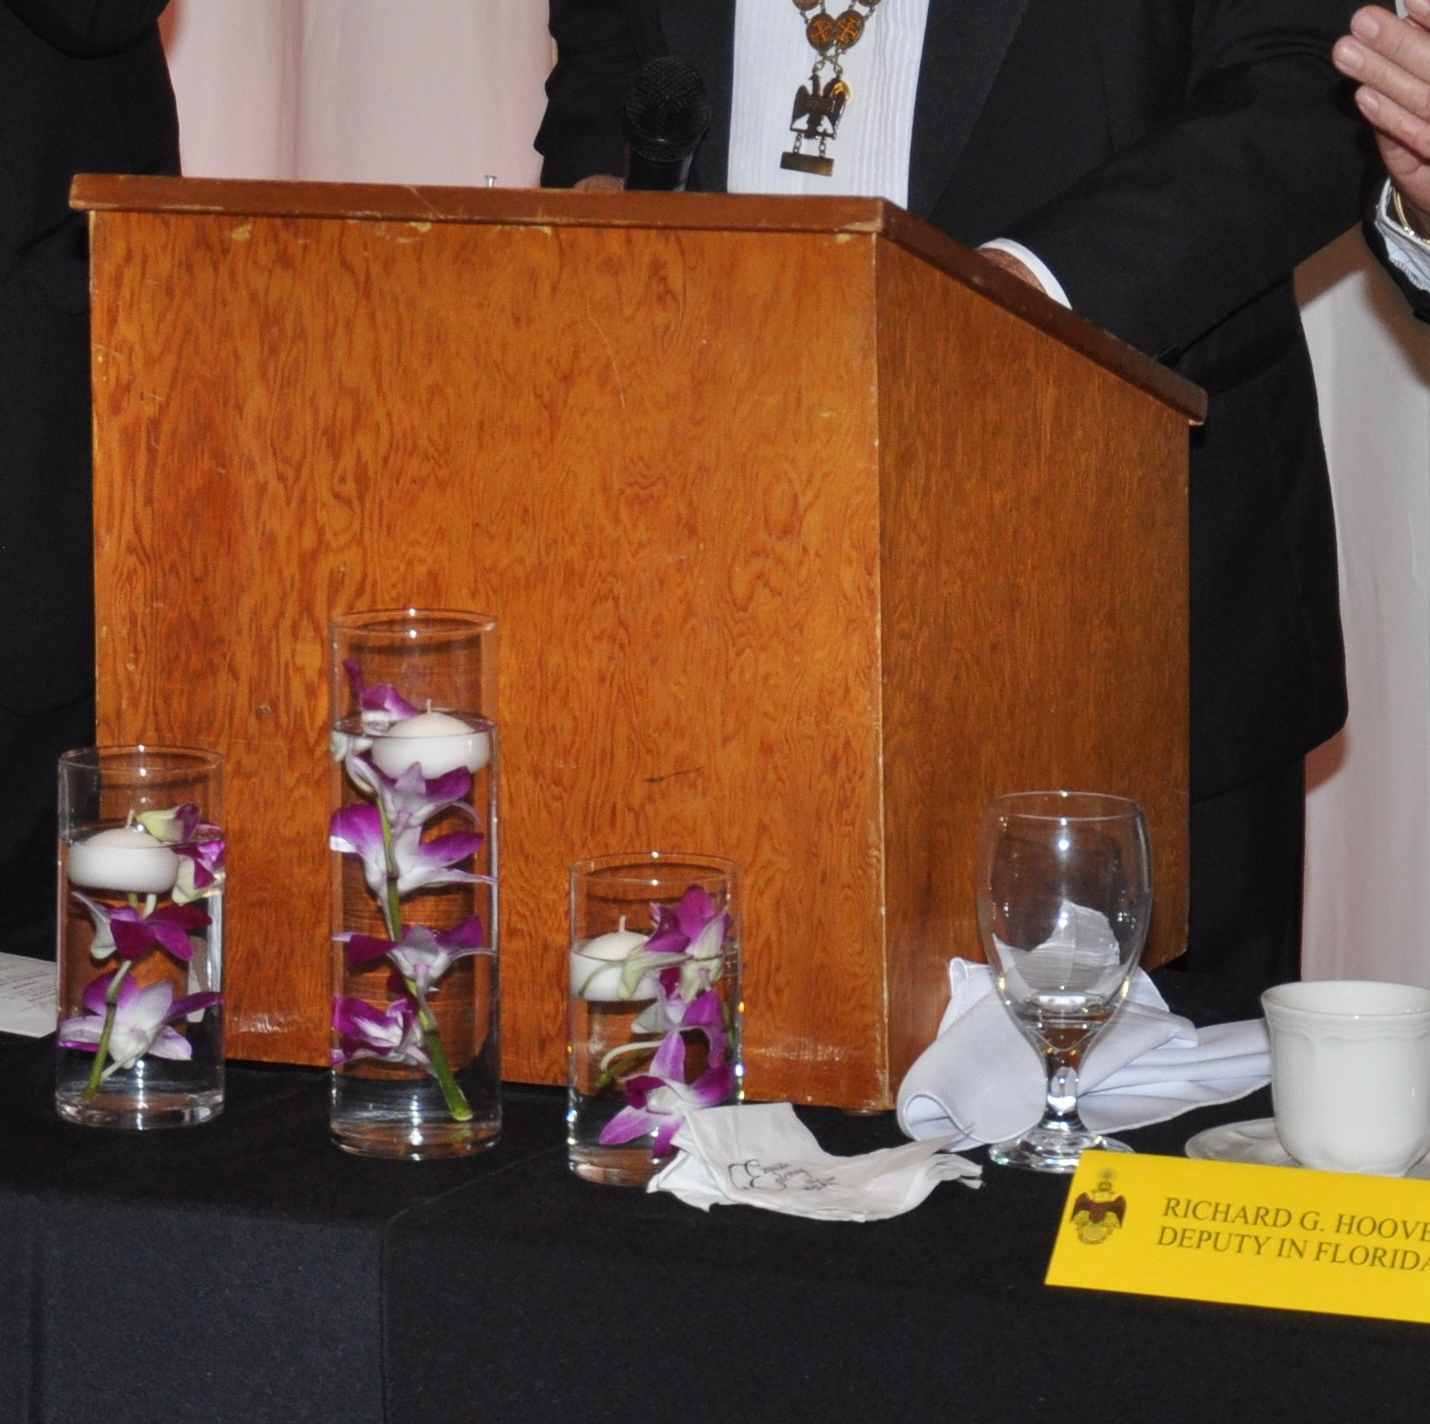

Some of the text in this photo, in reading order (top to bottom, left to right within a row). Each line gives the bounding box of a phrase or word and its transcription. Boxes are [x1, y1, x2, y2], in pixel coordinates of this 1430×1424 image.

[1162, 1197, 1293, 1228] RICHARD
[1299, 1210, 1325, 1232] G.
[1156, 1225, 1271, 1256] DEPUTY
[1276, 1237, 1308, 1259] IN
